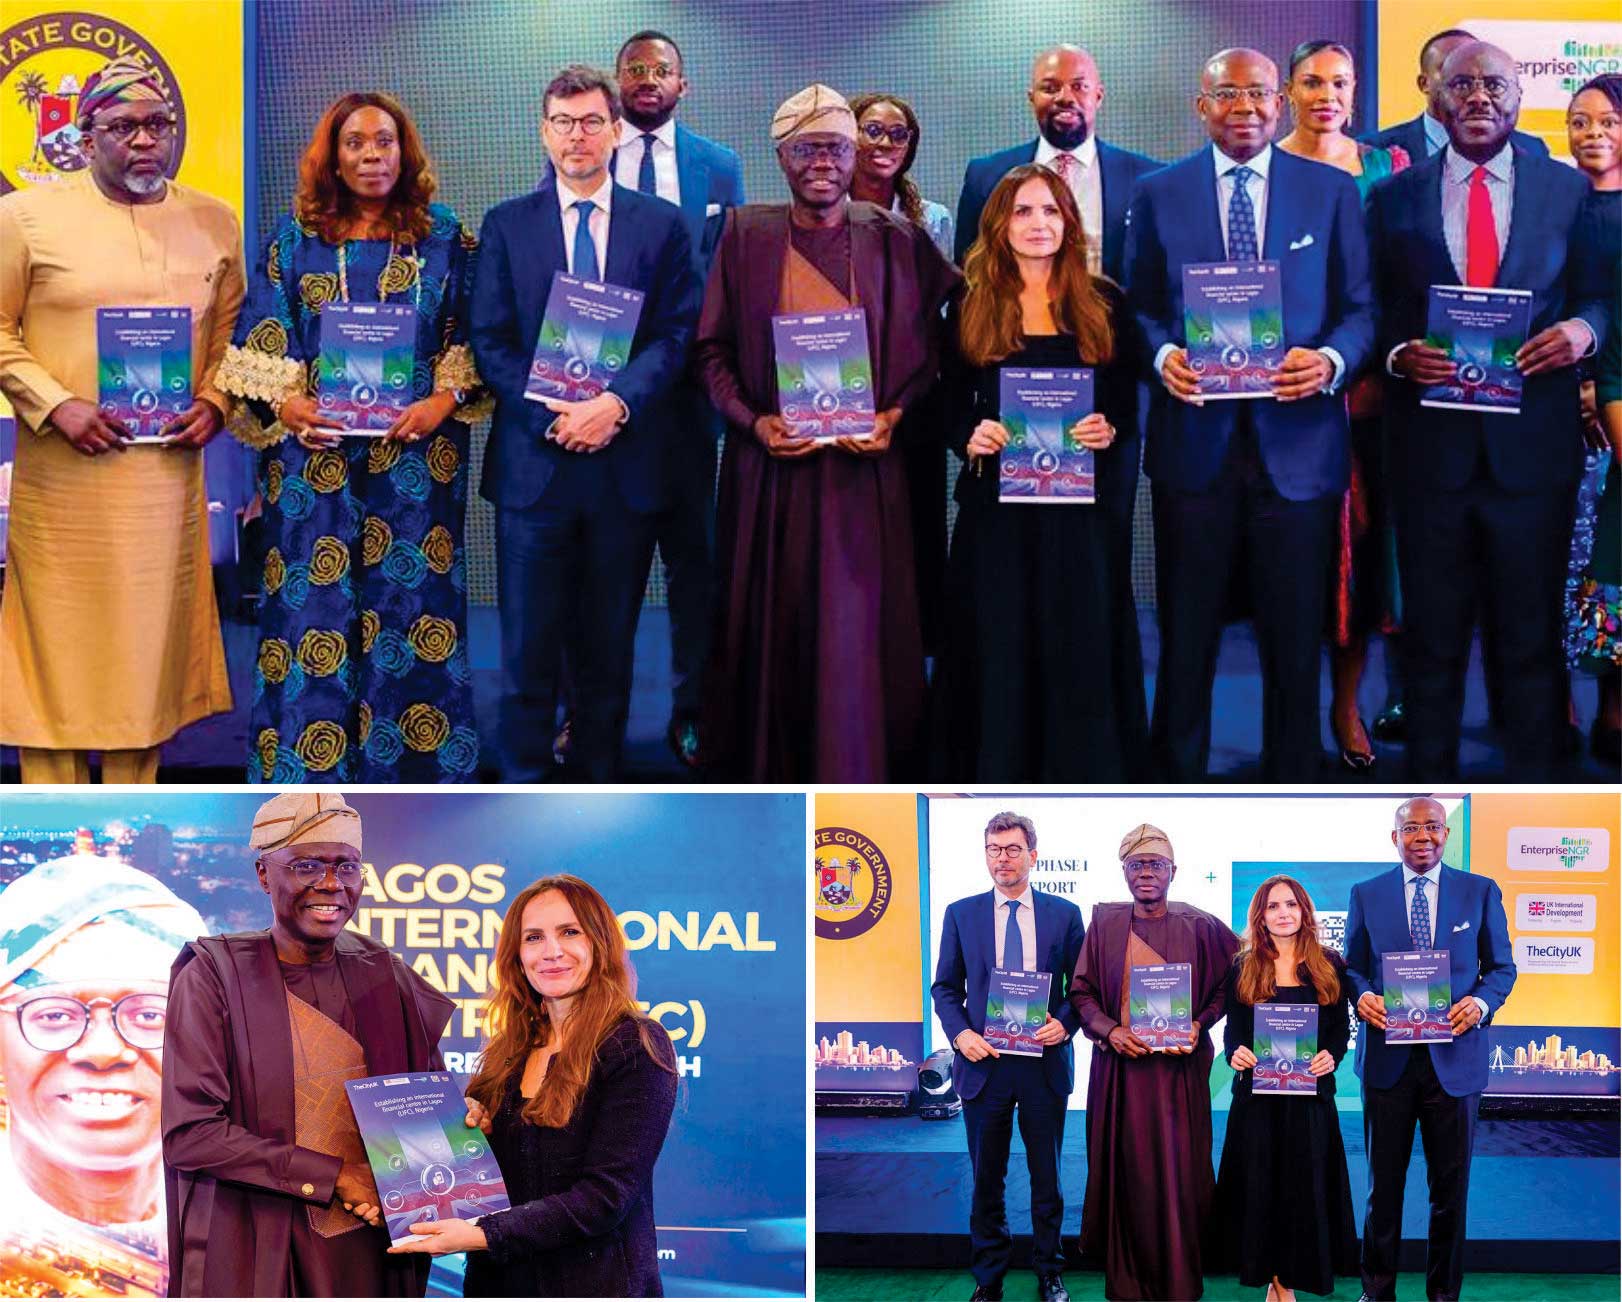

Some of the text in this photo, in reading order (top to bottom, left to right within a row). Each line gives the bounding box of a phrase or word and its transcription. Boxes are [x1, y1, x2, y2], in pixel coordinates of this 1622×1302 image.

[1520, 845, 1590, 857] EnterpriseNGR
[1036, 859, 1082, 872] PHASE
[834, 832, 888, 919] GOVERNMENT
[361, 863, 506, 904] AGOS
[1030, 881, 1077, 894] PORT
[1545, 908, 1584, 918] Development
[1526, 945, 1582, 959] TheCityUK
